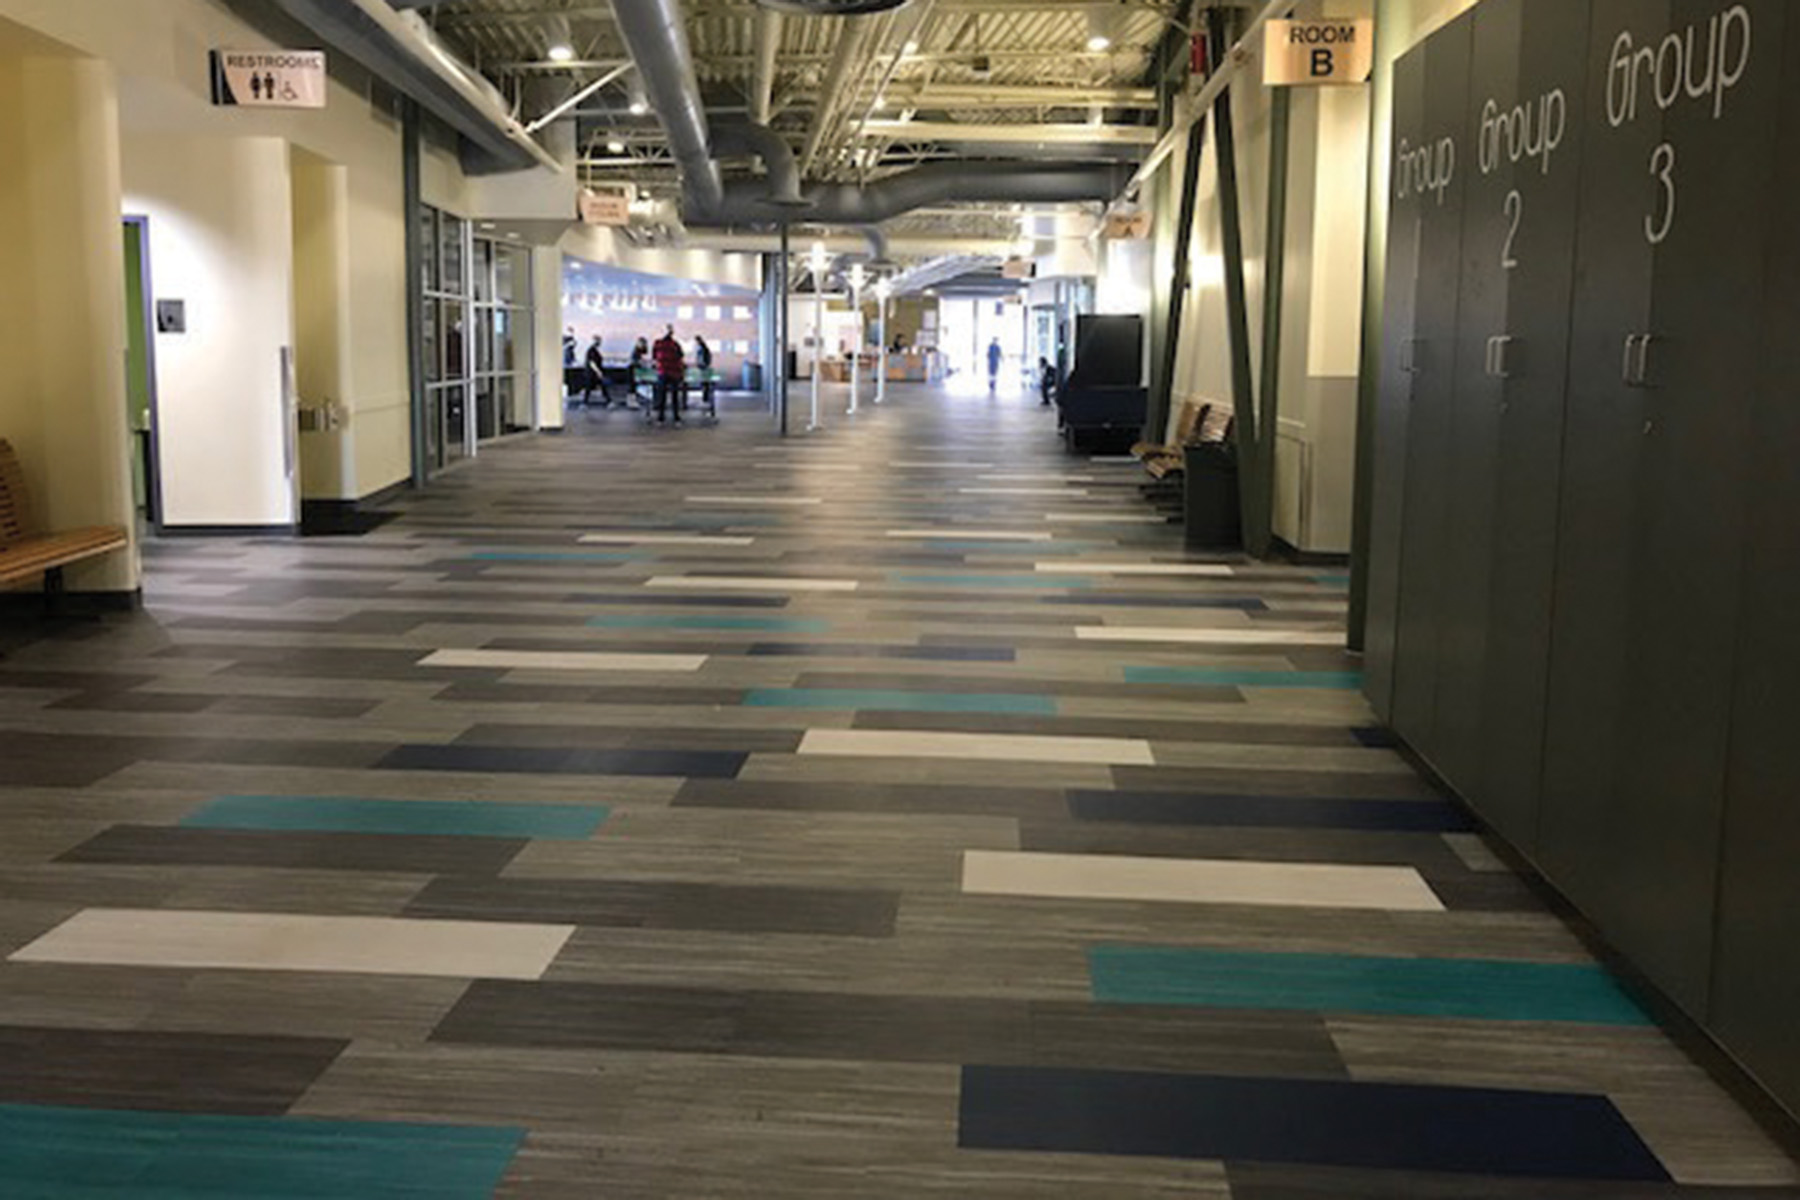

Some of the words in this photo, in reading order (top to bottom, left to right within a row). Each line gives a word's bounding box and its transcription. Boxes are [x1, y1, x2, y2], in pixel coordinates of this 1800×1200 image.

[226, 55, 320, 69] RESTROOMS
[1289, 25, 1356, 43] ROOM
[1311, 49, 1333, 76] B
[1606, 4, 1751, 127] Group
[1479, 88, 1566, 174] Group
[1396, 137, 1455, 205] Group
[1644, 142, 1675, 244] 3
[1501, 189, 1522, 268] 2
